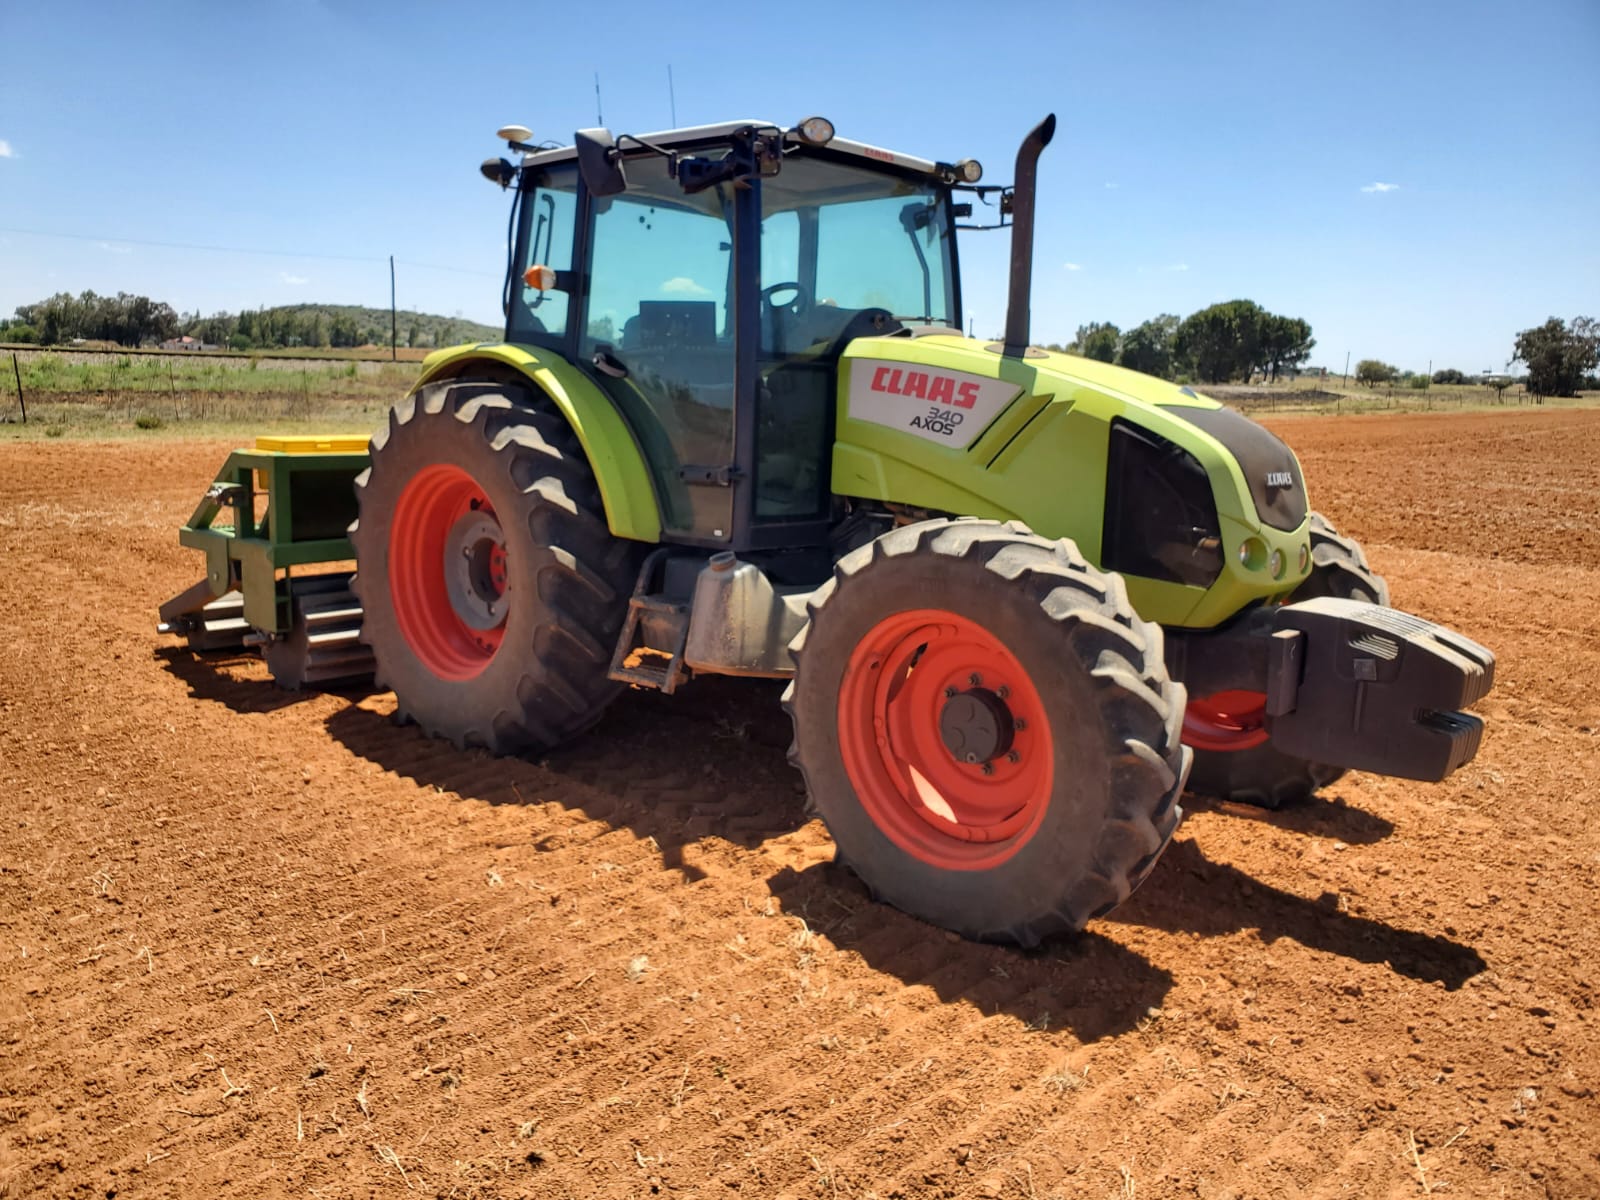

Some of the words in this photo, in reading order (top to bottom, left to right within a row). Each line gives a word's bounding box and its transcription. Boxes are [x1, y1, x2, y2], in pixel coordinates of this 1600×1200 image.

[871, 367, 980, 409] CLAAS
[909, 416, 954, 435] AXOS
[927, 407, 964, 426] 340
